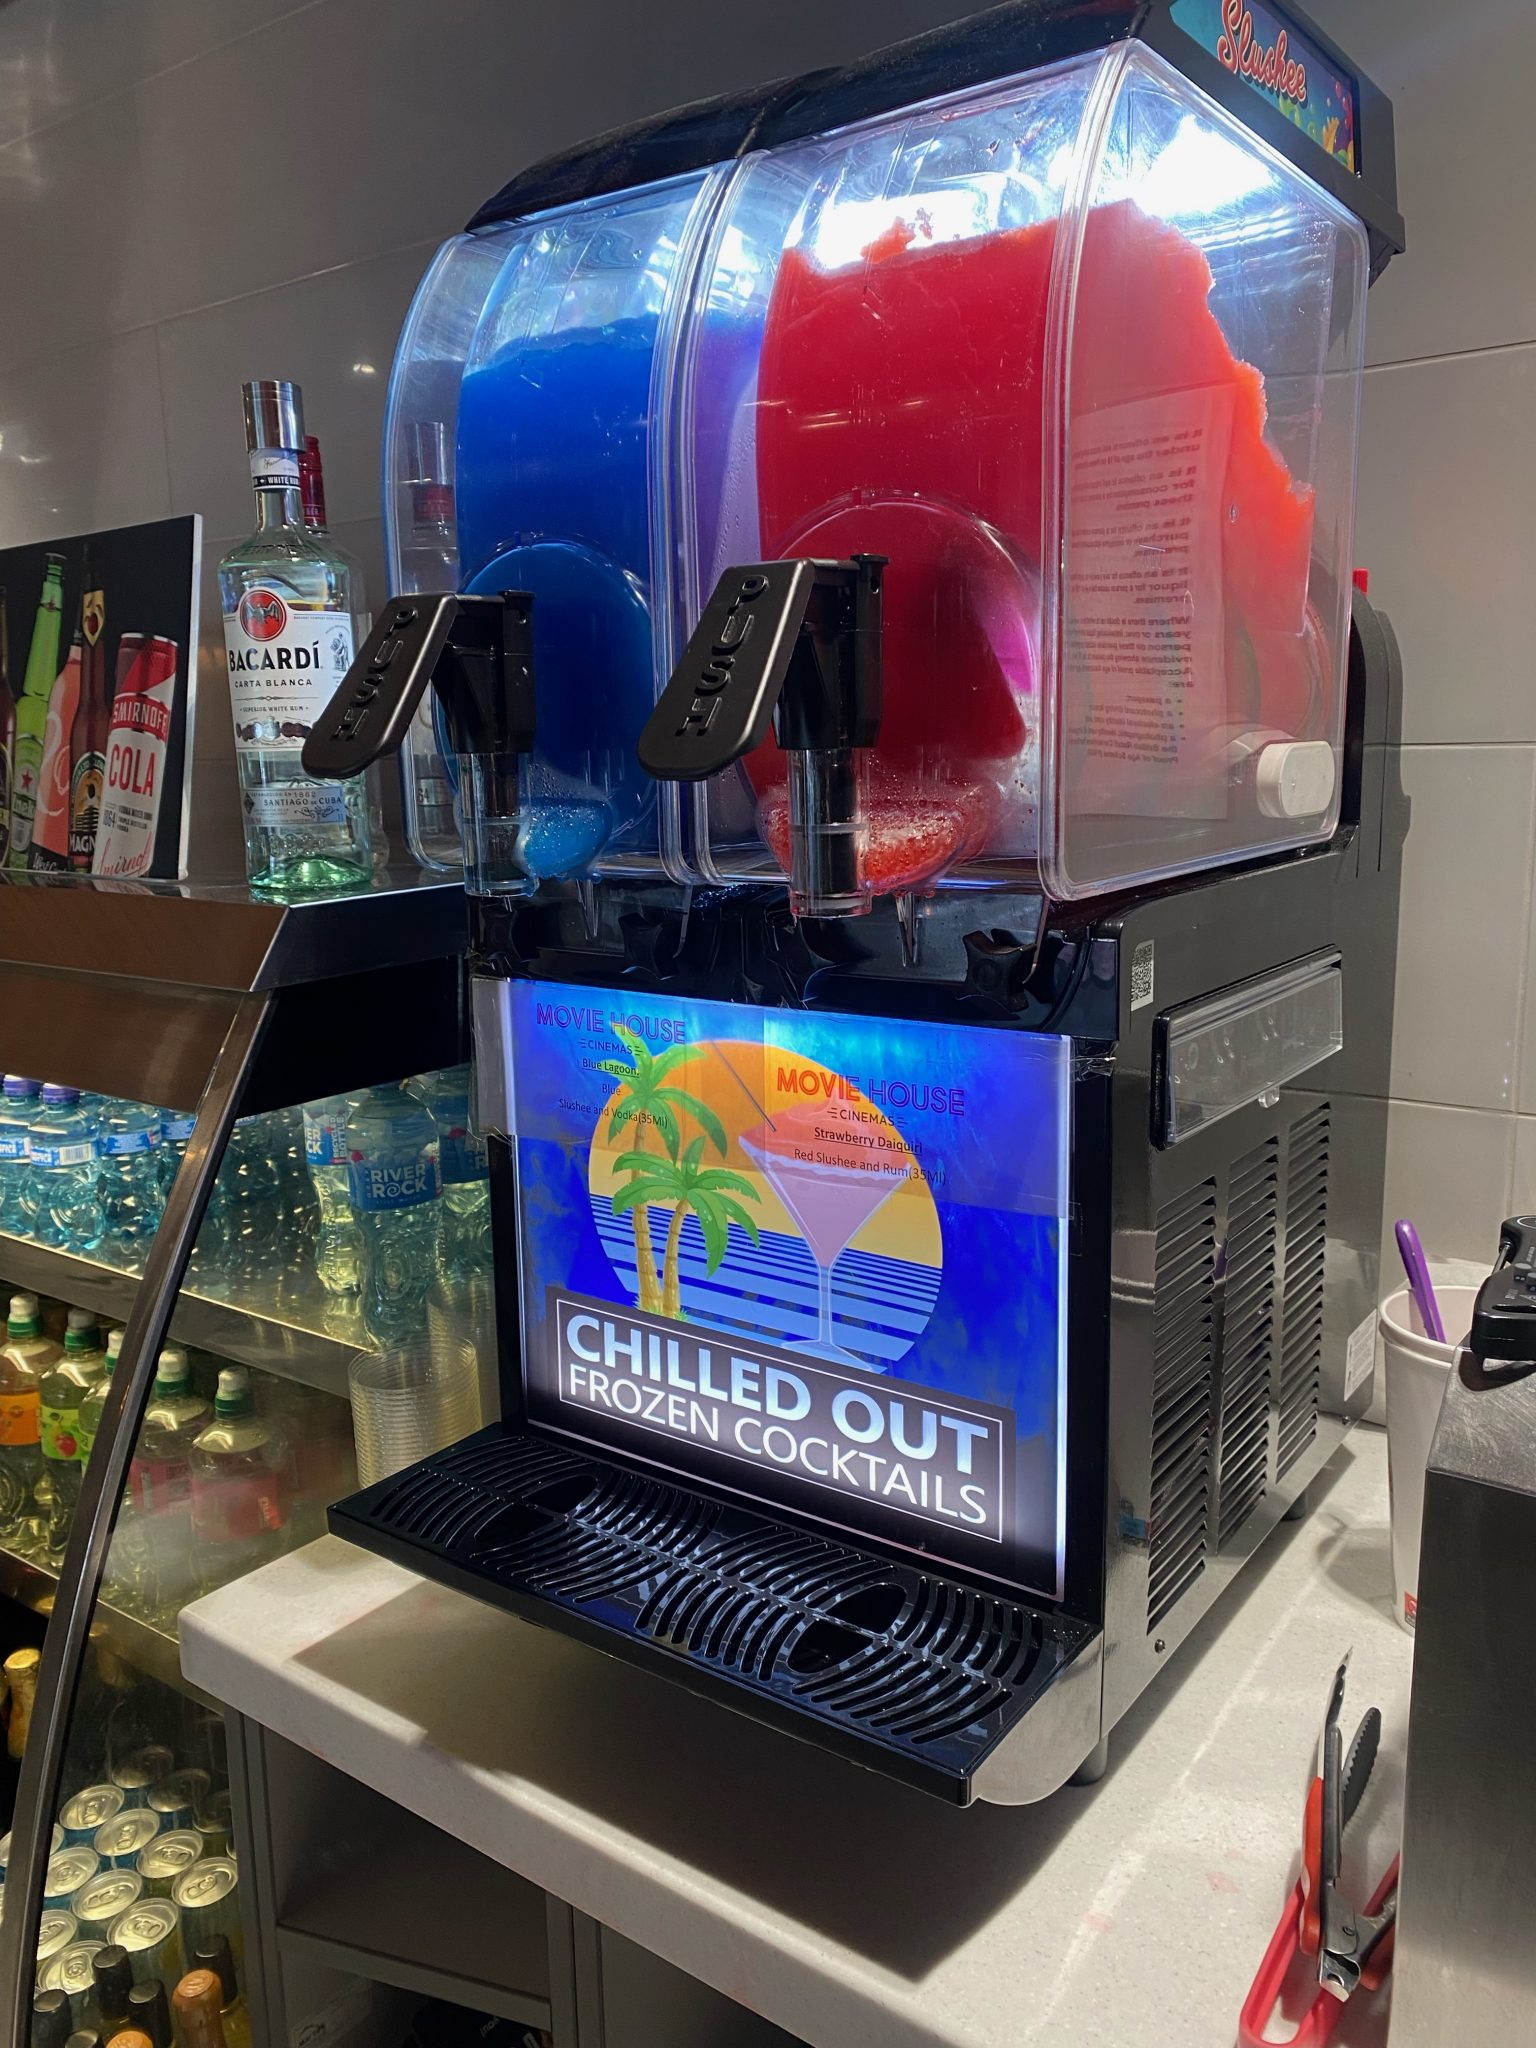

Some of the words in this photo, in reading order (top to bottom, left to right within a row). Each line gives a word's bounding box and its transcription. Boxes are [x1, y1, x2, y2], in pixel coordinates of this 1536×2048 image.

[1217, 0, 1307, 102] Slushee
[229, 640, 320, 672] BACARDÍ
[235, 679, 261, 689] CARTA
[266, 678, 312, 687] BLANCA
[109, 744, 155, 797] COLA
[264, 798, 309, 806] SANTIAGO
[318, 796, 342, 805] CUBA
[537, 1003, 604, 1033] MOVIE
[610, 1012, 686, 1044] HOUSE
[588, 1040, 633, 1055] CINEMAS
[582, 1058, 602, 1070] Blue
[602, 1083, 621, 1096] Blue
[777, 1067, 861, 1101] MOVIE
[868, 1078, 965, 1117] HOUSE
[559, 1099, 591, 1114] Slushee
[593, 1106, 609, 1117] and
[839, 1109, 895, 1127] CINEMAS
[814, 1127, 874, 1148] Strawberry
[878, 1136, 923, 1154] Daiquiri
[371, 1163, 426, 1183] RIVER
[794, 1149, 813, 1162] Red
[816, 1149, 856, 1169] Slushee
[859, 1160, 880, 1173] and
[565, 1314, 812, 1423] CHILLED
[830, 1388, 989, 1475] OUT
[569, 1364, 720, 1443] FROZEN
[733, 1416, 988, 1525] COCKTAILS
